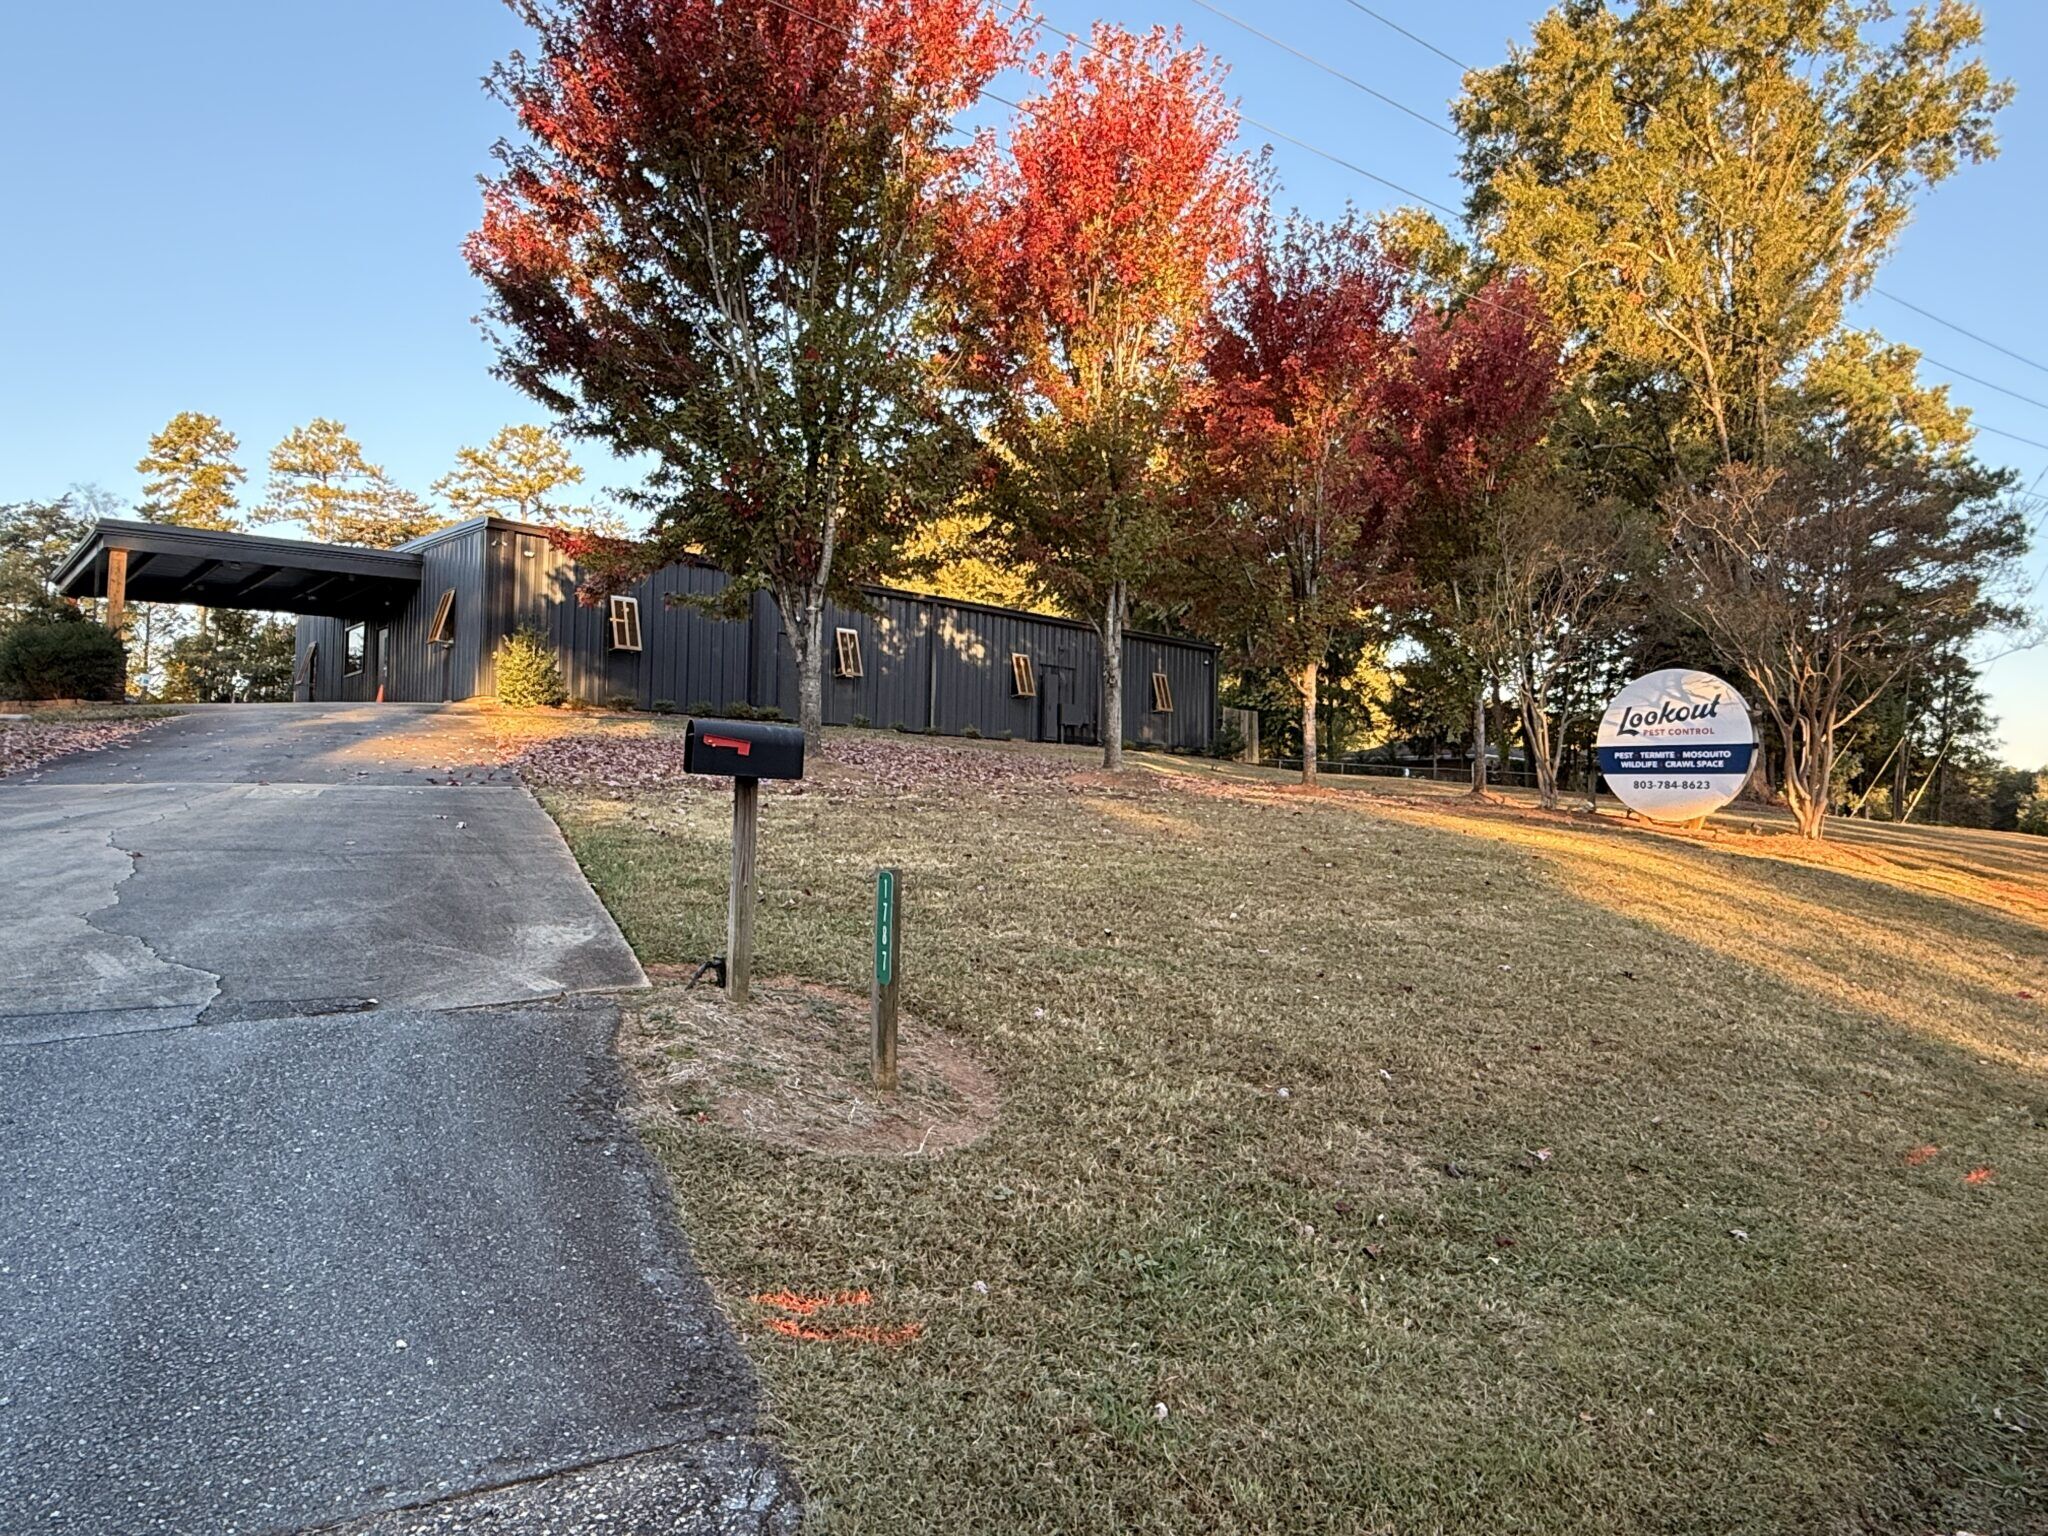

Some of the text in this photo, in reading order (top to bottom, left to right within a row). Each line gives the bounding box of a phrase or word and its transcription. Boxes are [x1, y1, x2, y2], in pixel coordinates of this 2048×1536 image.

[1617, 694, 1721, 736] Lookout
[1643, 727, 1715, 737] PEST CONTROL
[1614, 750, 1731, 760] PEST TERMITE MOSQUITO
[1621, 760, 1724, 768] WILDLIFE CRAWL SPACE
[1633, 780, 1711, 790] 803-784-8623
